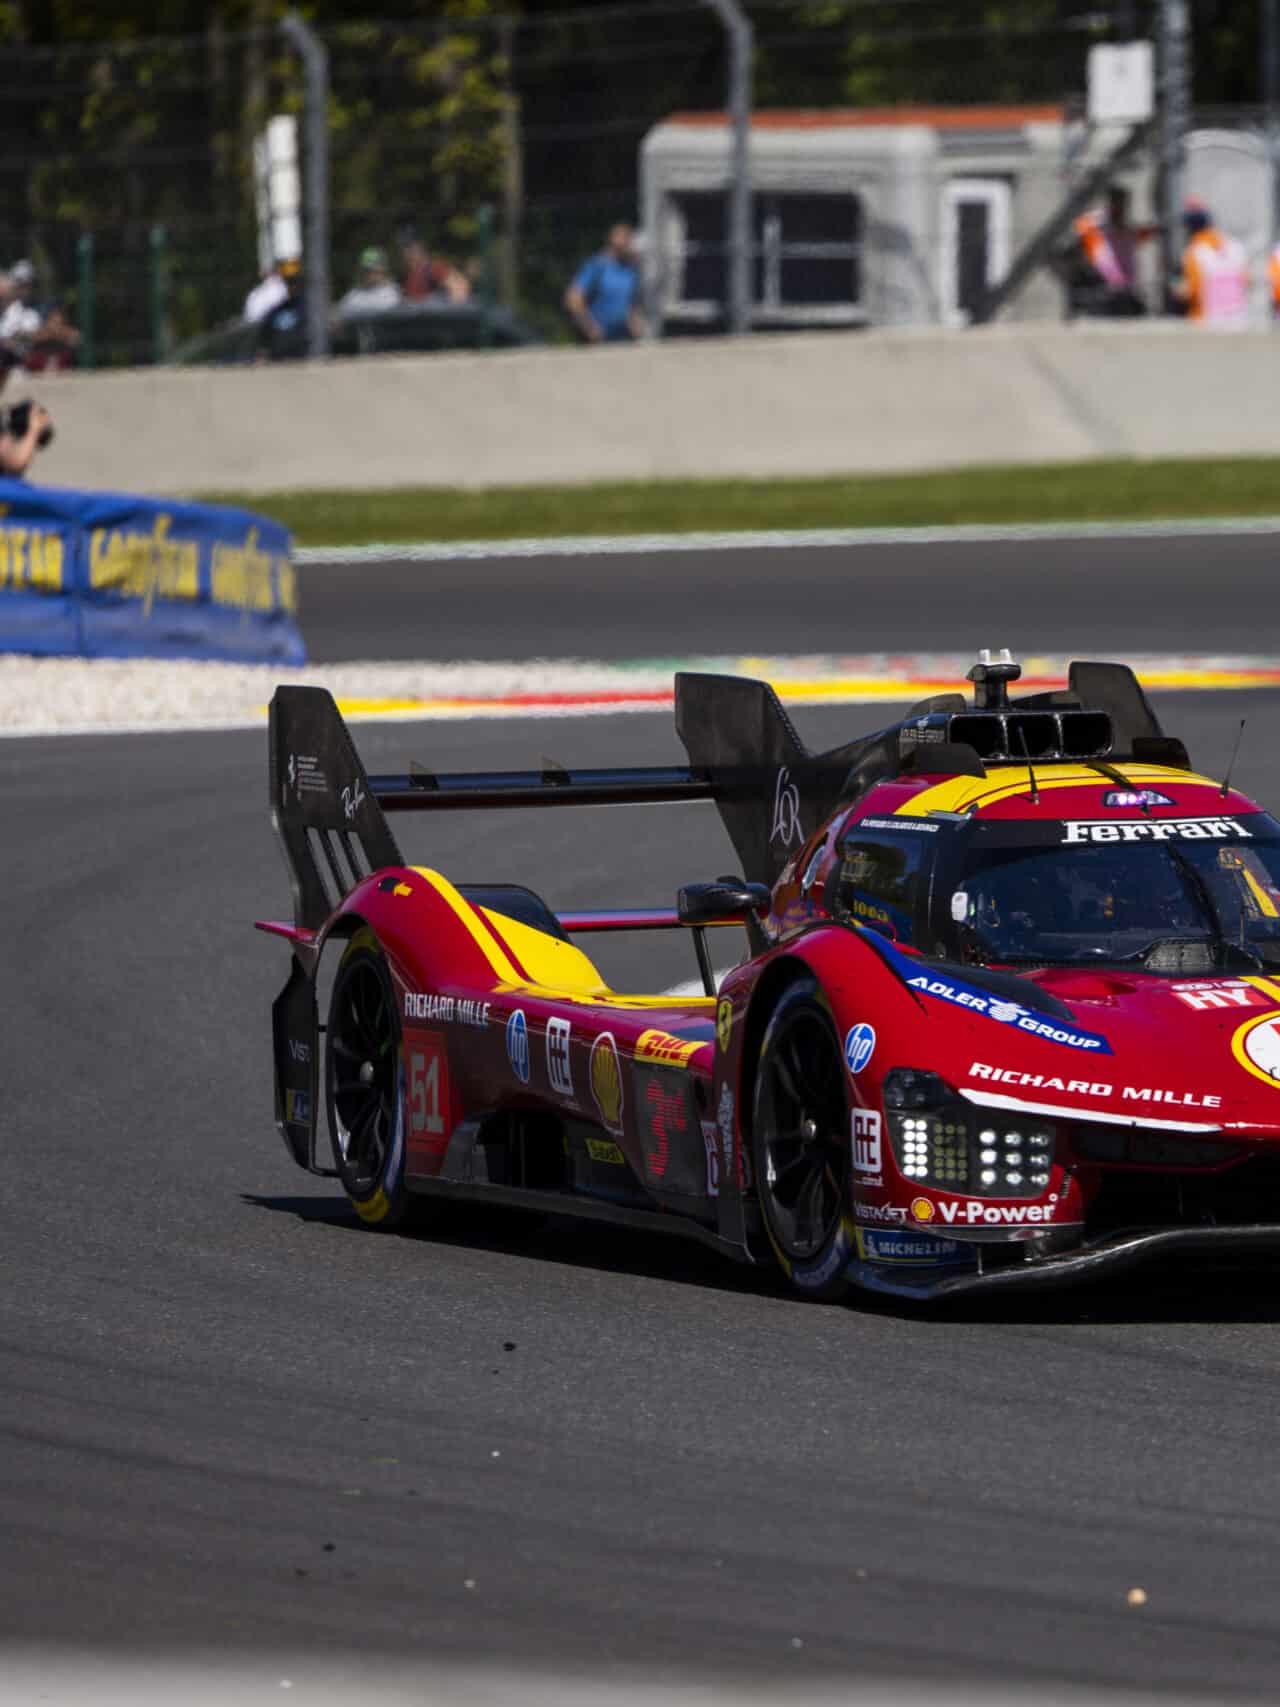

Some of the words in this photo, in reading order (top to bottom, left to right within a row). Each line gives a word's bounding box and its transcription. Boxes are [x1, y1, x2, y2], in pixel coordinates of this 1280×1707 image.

[1061, 817, 1253, 844] Ferrari
[404, 991, 454, 1022] RICHARD
[456, 999, 491, 1026] MILLE
[906, 976, 989, 1012] ADLER
[1017, 1016, 1101, 1049] GROUP
[1177, 988, 1252, 1009] HY
[847, 1025, 873, 1073] hp
[409, 1052, 445, 1134] 51
[968, 1062, 1113, 1096] RICHARD
[1122, 1087, 1222, 1108] MILLE
[938, 1200, 1056, 1224] V-Power
[878, 1239, 957, 1256] MICHELIN
